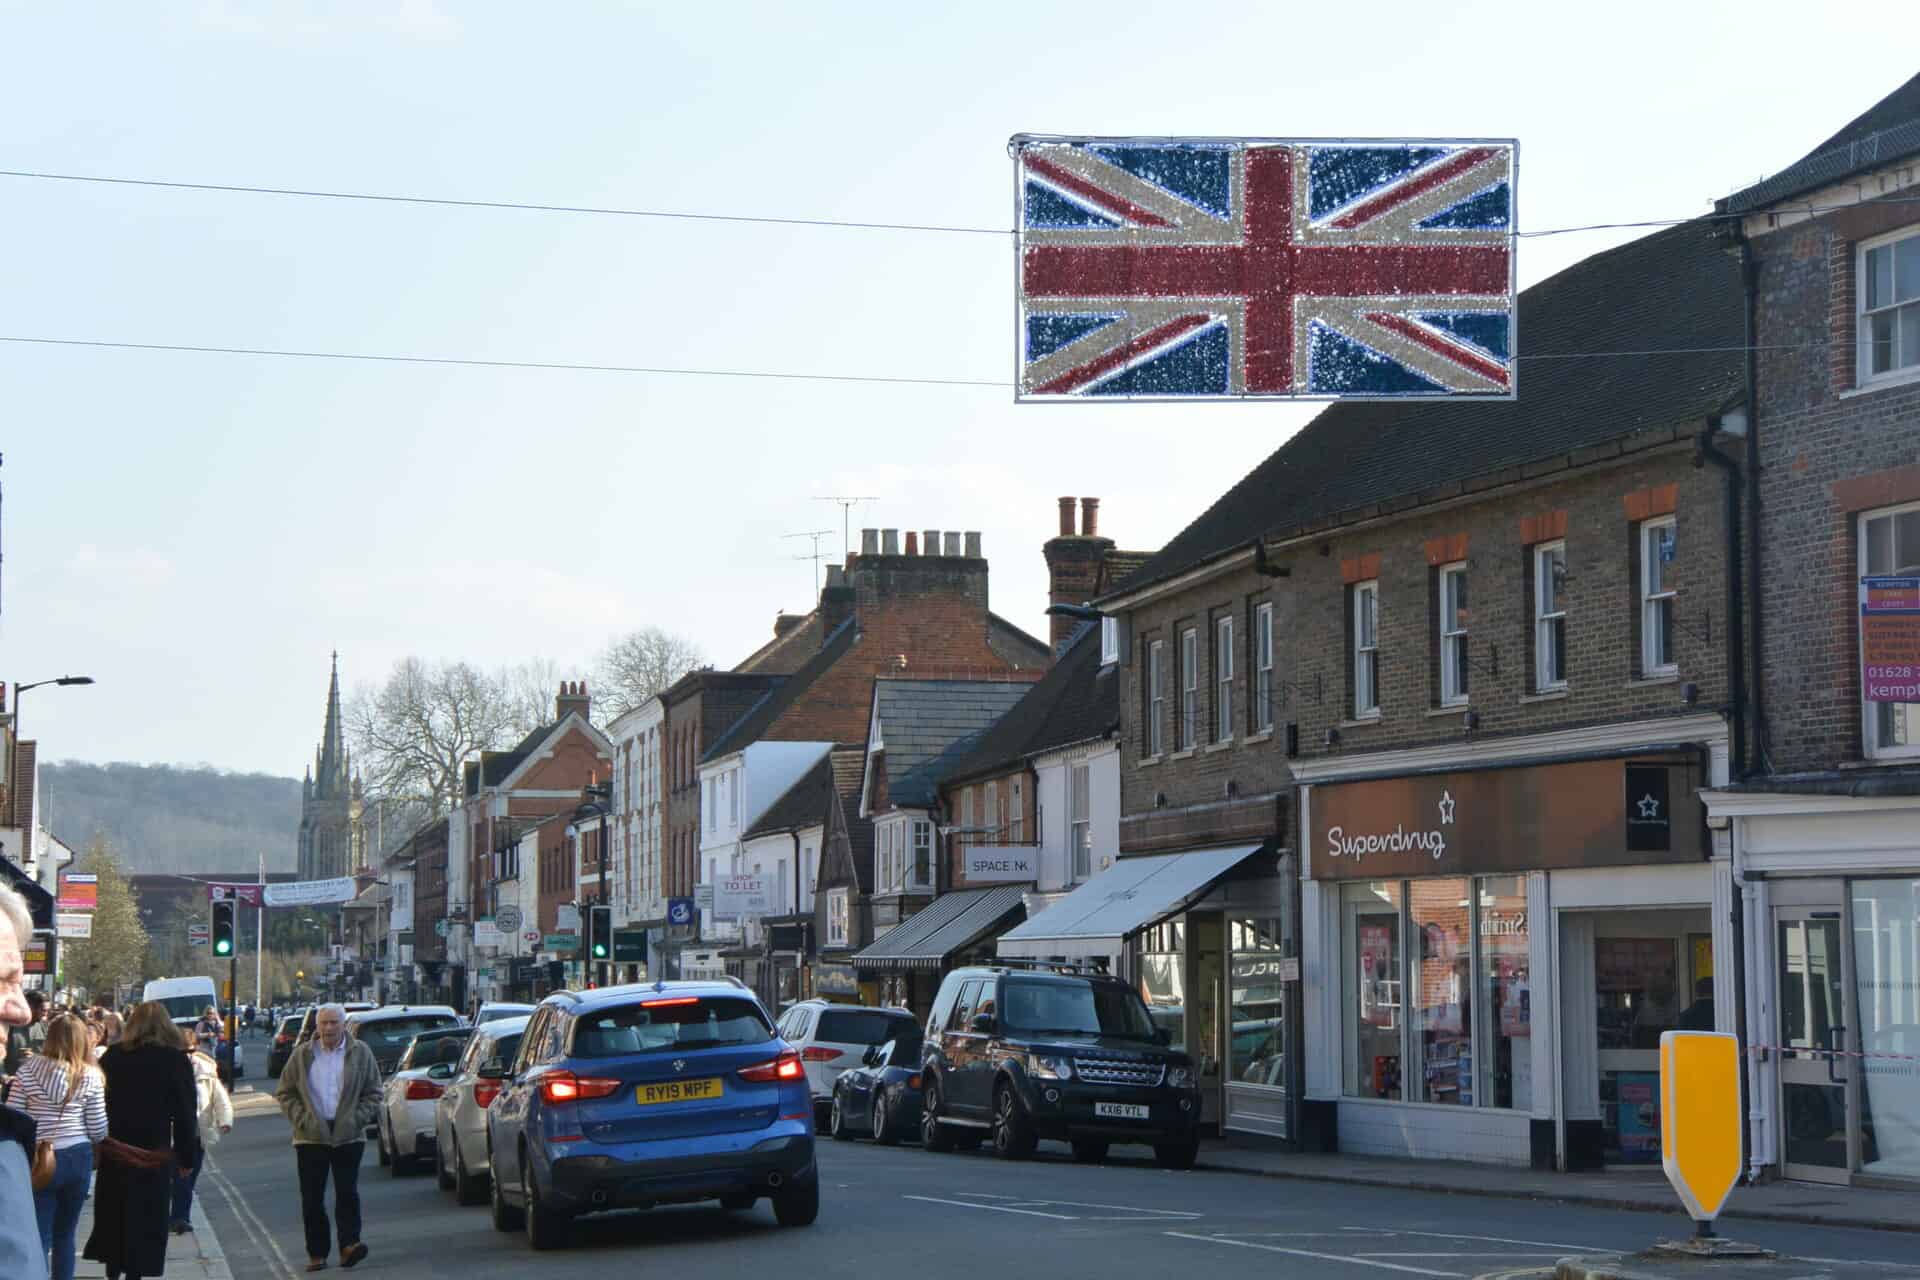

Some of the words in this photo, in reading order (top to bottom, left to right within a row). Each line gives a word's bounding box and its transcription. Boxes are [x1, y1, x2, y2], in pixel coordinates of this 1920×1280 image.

[1868, 666, 1912, 678] 01628
[1328, 823, 1446, 861] Superdrug
[725, 881, 740, 891] TO
